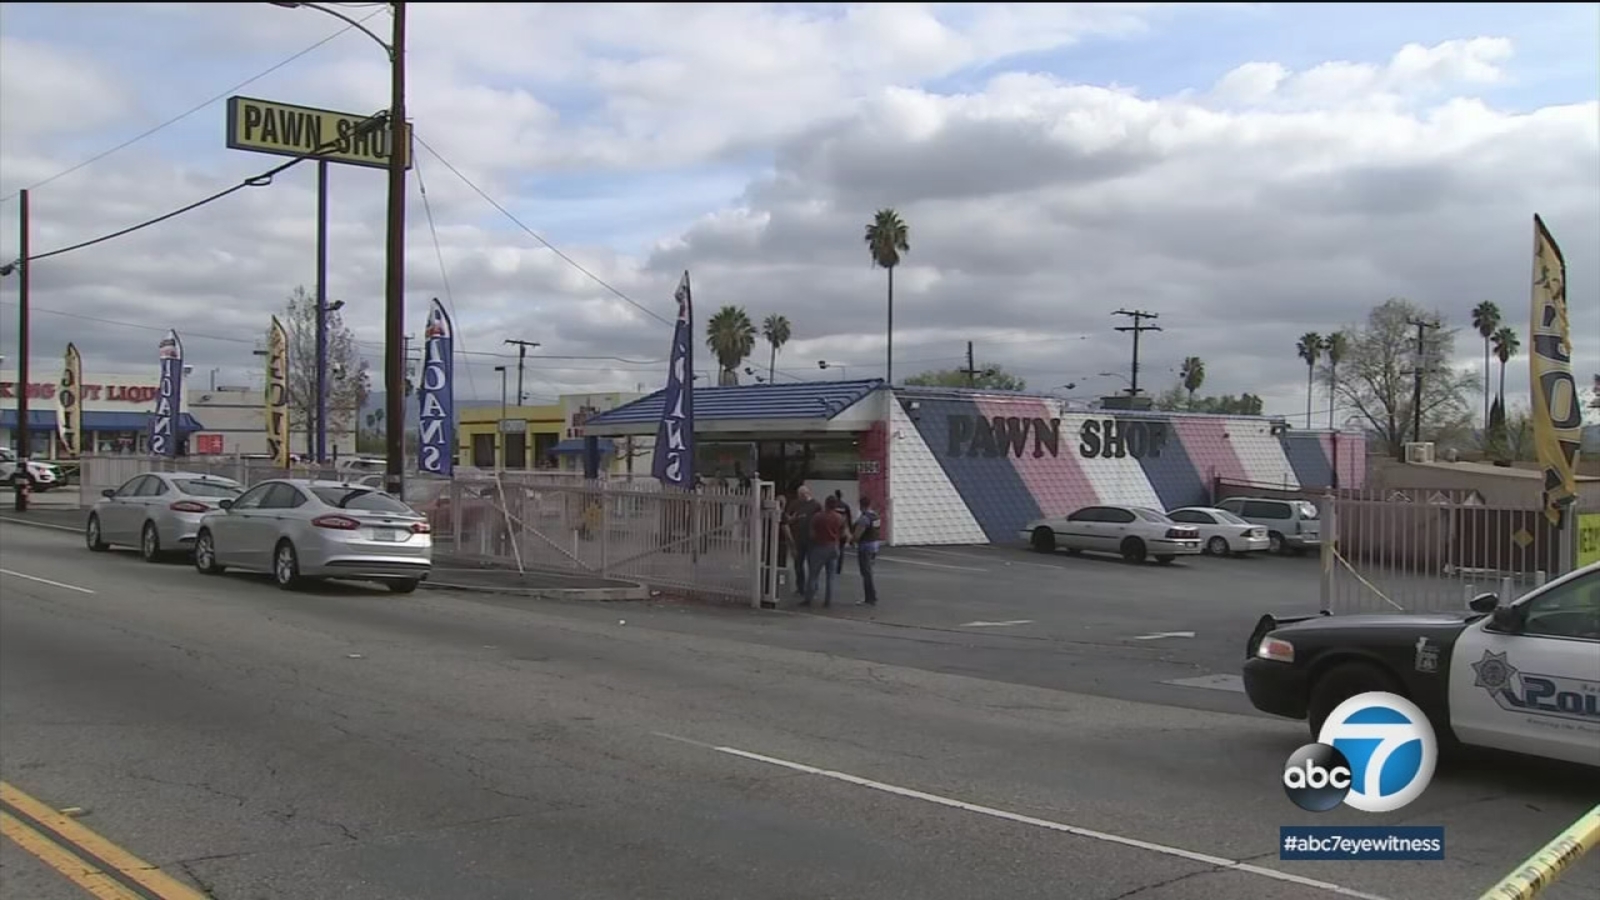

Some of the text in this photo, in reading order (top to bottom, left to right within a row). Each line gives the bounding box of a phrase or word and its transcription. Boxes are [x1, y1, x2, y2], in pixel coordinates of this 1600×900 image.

[244, 104, 388, 158] PAWN SHO
[0, 382, 56, 400] KNG
[106, 386, 159, 403] LIQU
[947, 414, 1167, 459] PAWN SHOP
